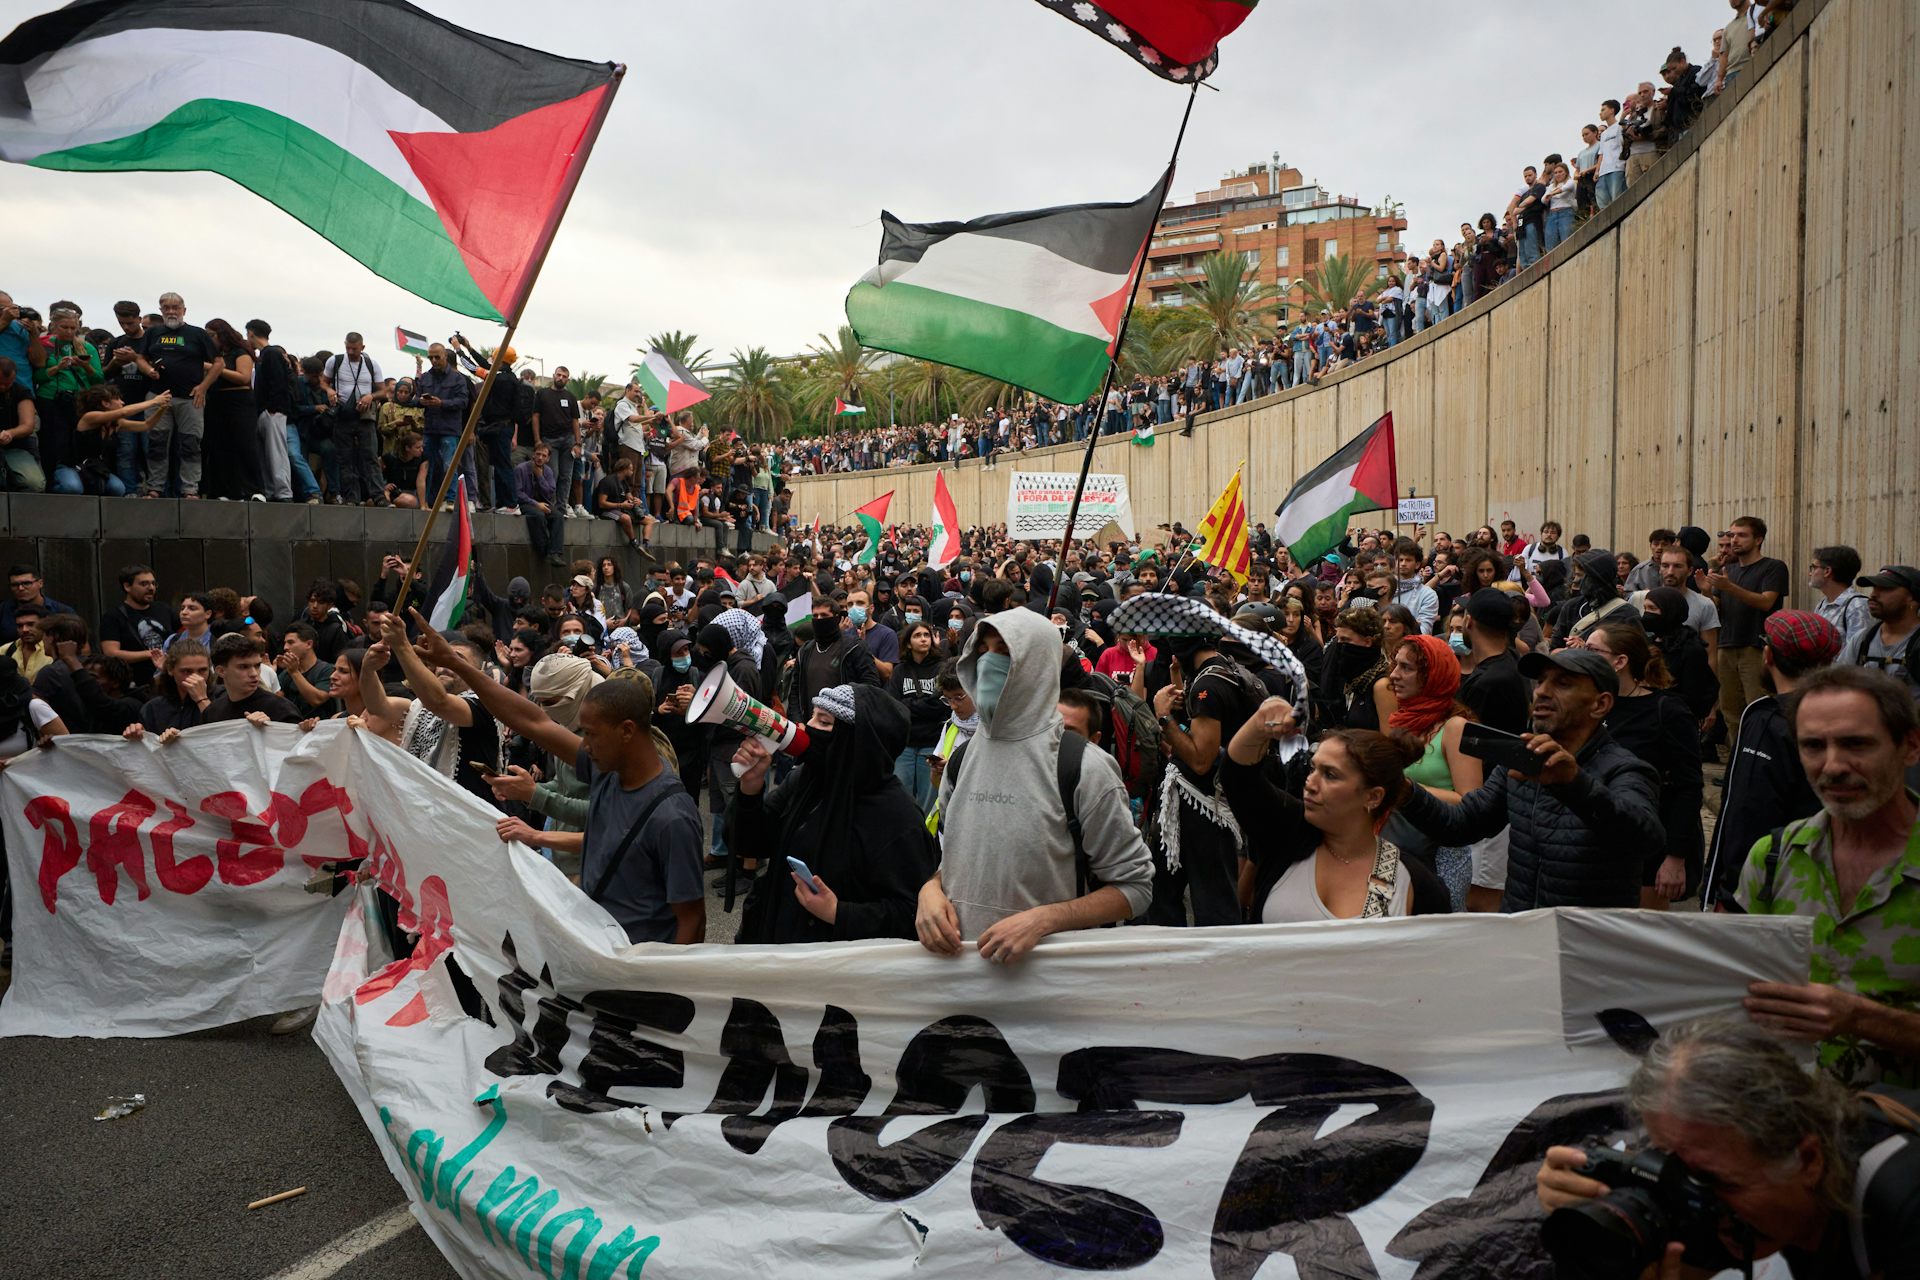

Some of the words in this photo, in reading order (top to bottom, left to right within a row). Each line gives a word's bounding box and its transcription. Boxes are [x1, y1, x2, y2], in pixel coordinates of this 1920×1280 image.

[1067, 494, 1115, 503] PESTINA
[1408, 500, 1425, 510] TRUTH
[1399, 510, 1434, 521] NSTOPPABLE
